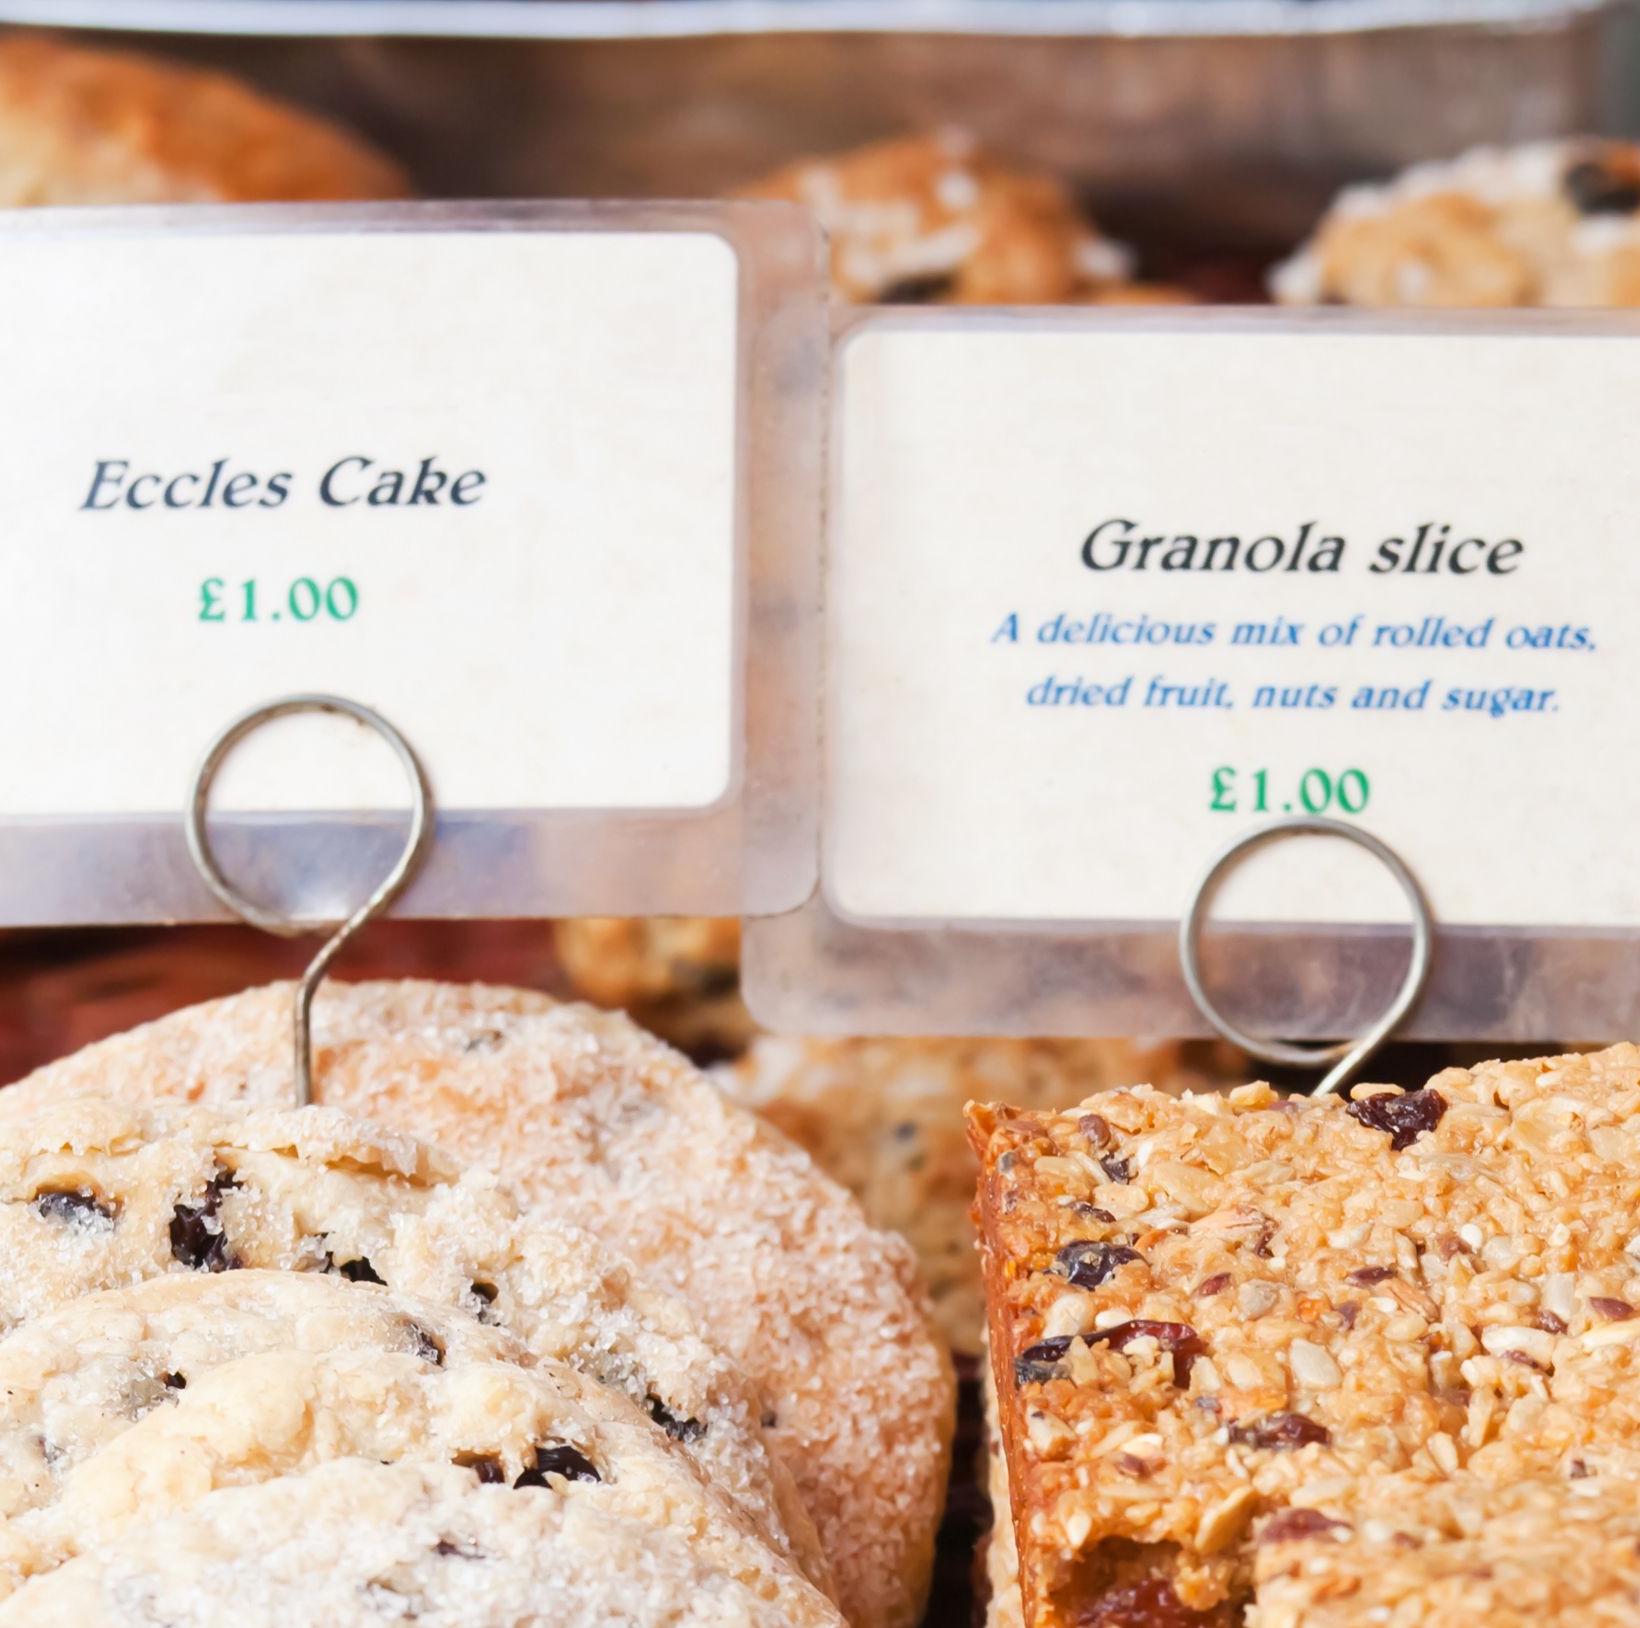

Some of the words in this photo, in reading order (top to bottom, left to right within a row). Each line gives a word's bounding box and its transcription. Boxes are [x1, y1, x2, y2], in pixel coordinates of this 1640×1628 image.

[80, 459, 293, 510] Eccles
[319, 456, 487, 508] Cake
[1080, 519, 1346, 574] Granola
[1368, 522, 1524, 576] slice
[198, 576, 359, 622] £1.00
[989, 612, 1020, 645] A
[1037, 613, 1216, 645] delicious
[1230, 617, 1303, 645] mix
[1317, 614, 1367, 646] of
[1373, 617, 1494, 648] rolled
[1505, 624, 1596, 651] oats,
[1027, 675, 1133, 706] dried
[1144, 676, 1233, 709] fruit,
[1252, 684, 1337, 709] nuts
[1351, 680, 1432, 710] and
[1442, 688, 1557, 718] sugar.
[1208, 766, 1371, 814] £1.00
